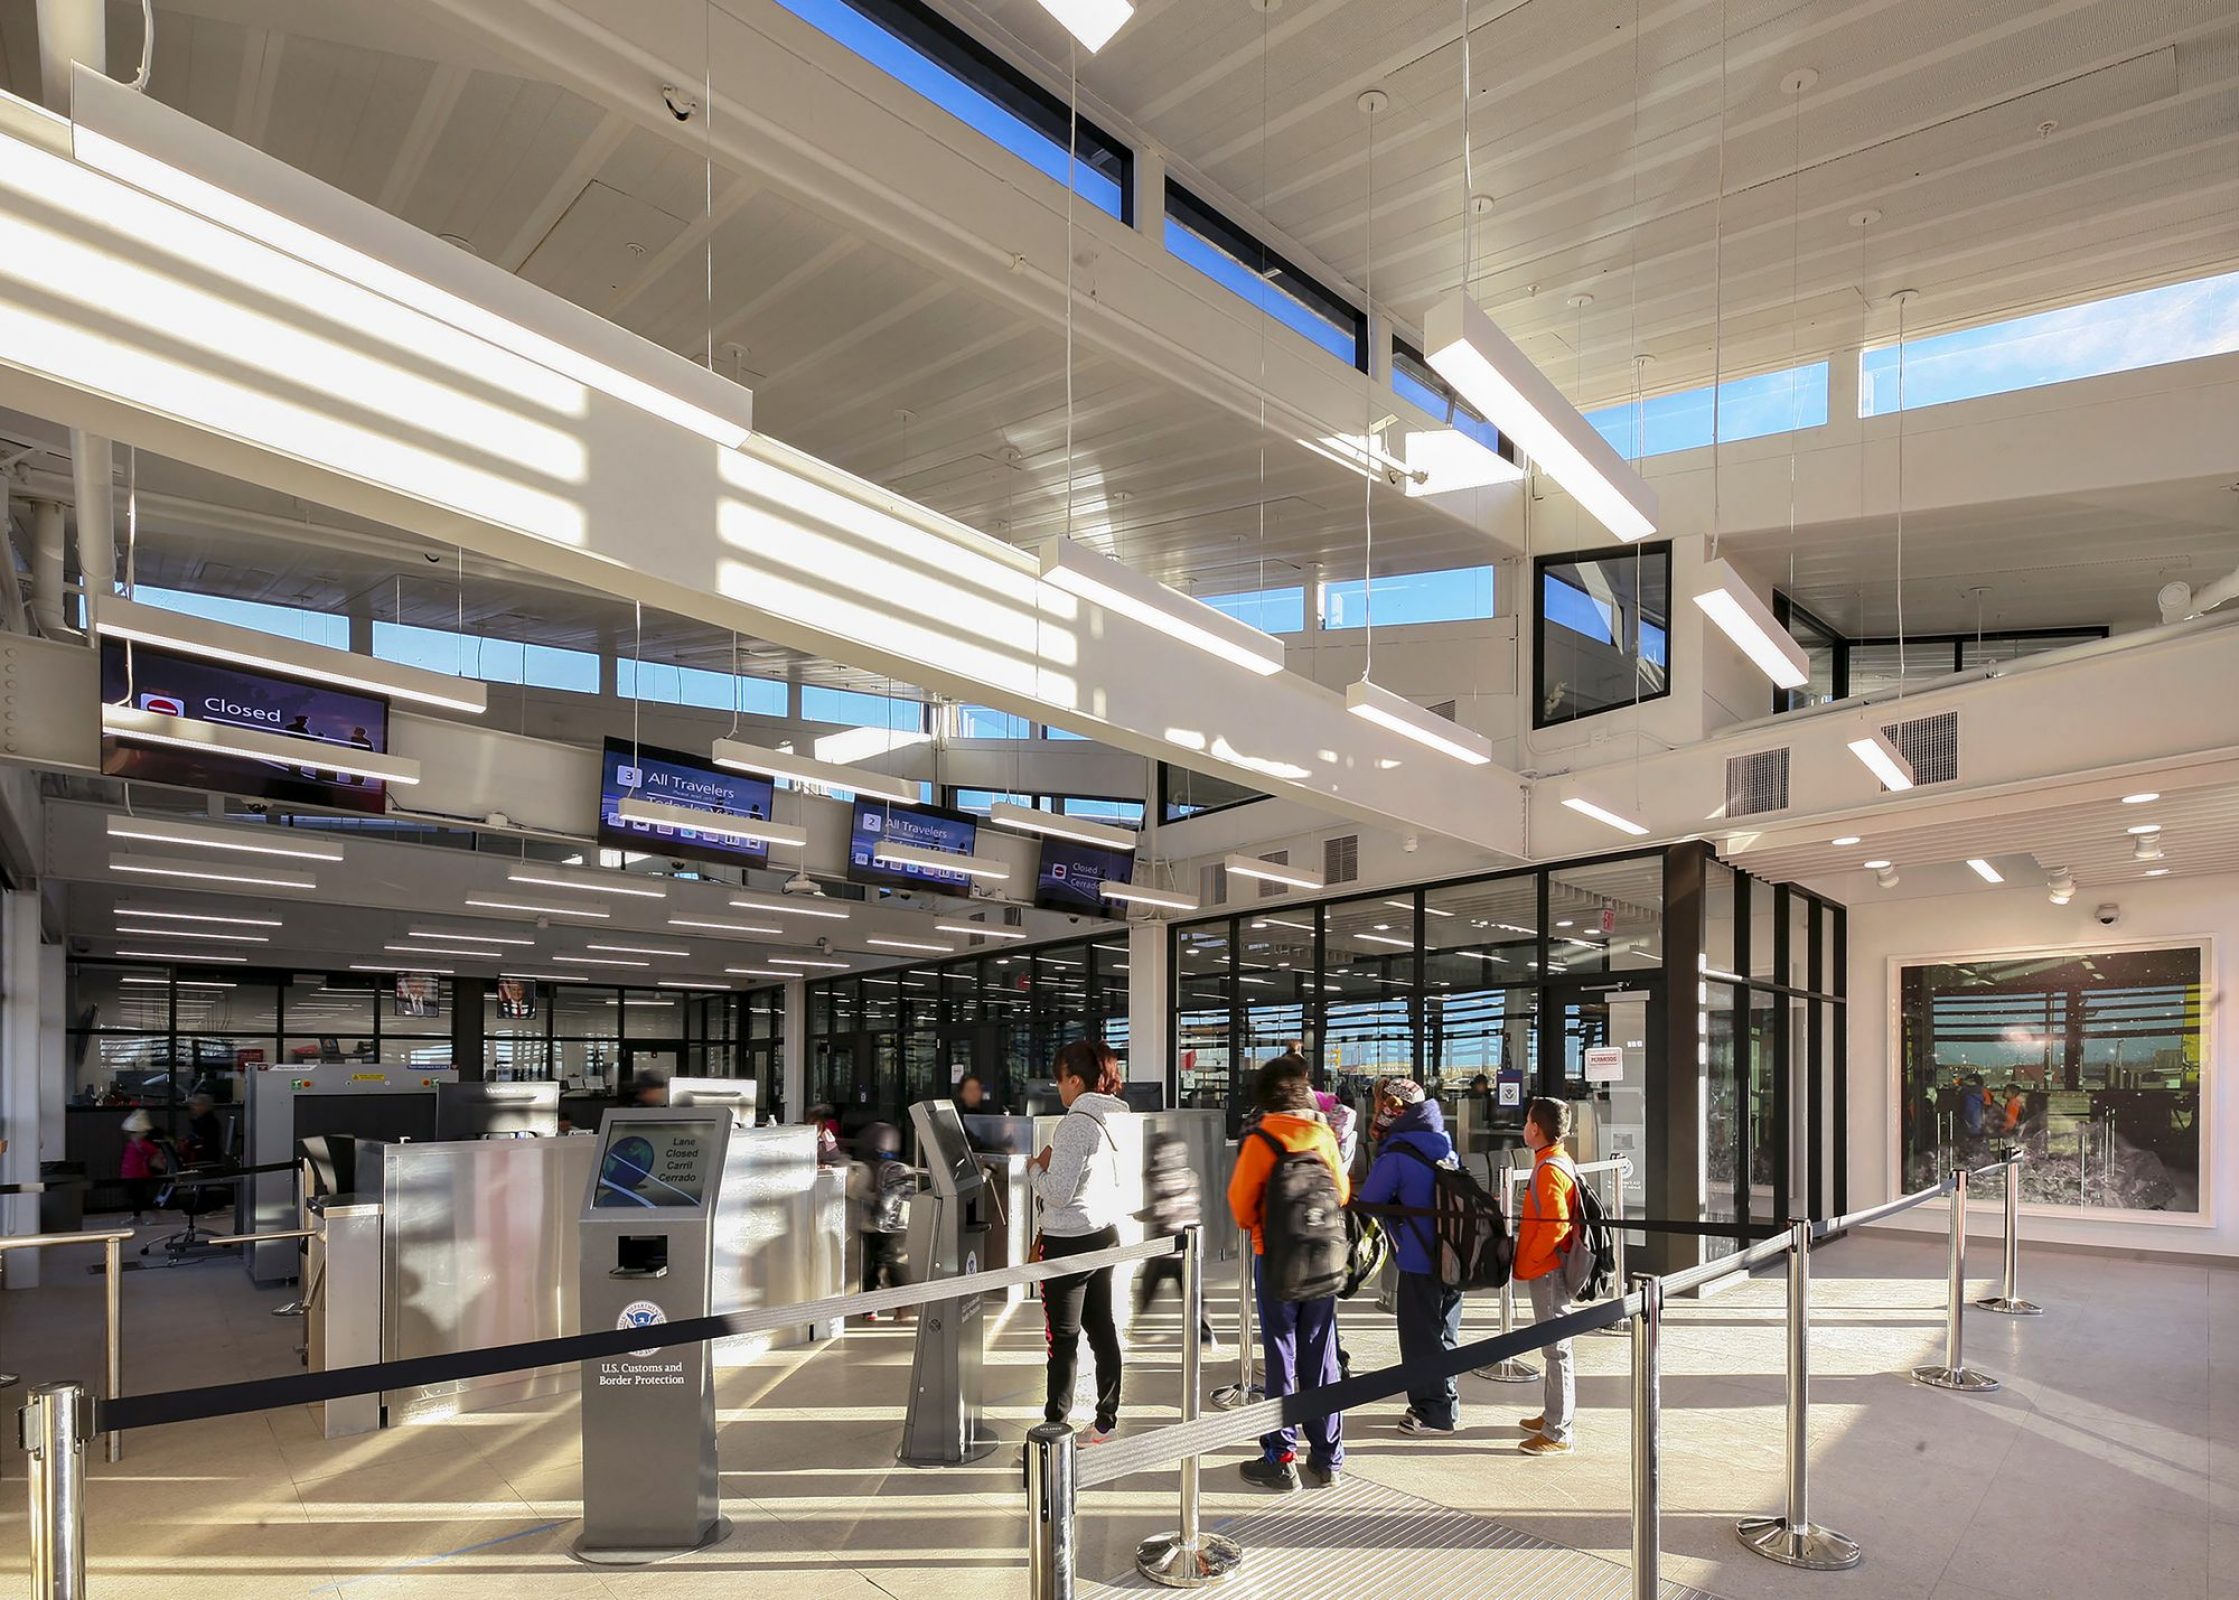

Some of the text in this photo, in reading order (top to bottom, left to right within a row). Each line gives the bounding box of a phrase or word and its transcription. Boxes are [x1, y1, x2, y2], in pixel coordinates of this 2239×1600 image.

[204, 697, 281, 723] Closed
[625, 770, 634, 781] 3
[648, 772, 735, 799] All Travelers
[867, 817, 875, 826] 2
[885, 818, 900, 830] All
[902, 821, 947, 839] Travelers
[1072, 862, 1098, 874] Closed
[1070, 878, 1100, 890] Cerrado
[673, 1137, 696, 1146] Lane
[666, 1149, 699, 1158] Closed
[667, 1161, 693, 1170] Carril
[658, 1173, 696, 1182] Cerrado
[601, 1362, 683, 1373] U.S. Customs and
[600, 1375, 685, 1385] Border Protection
